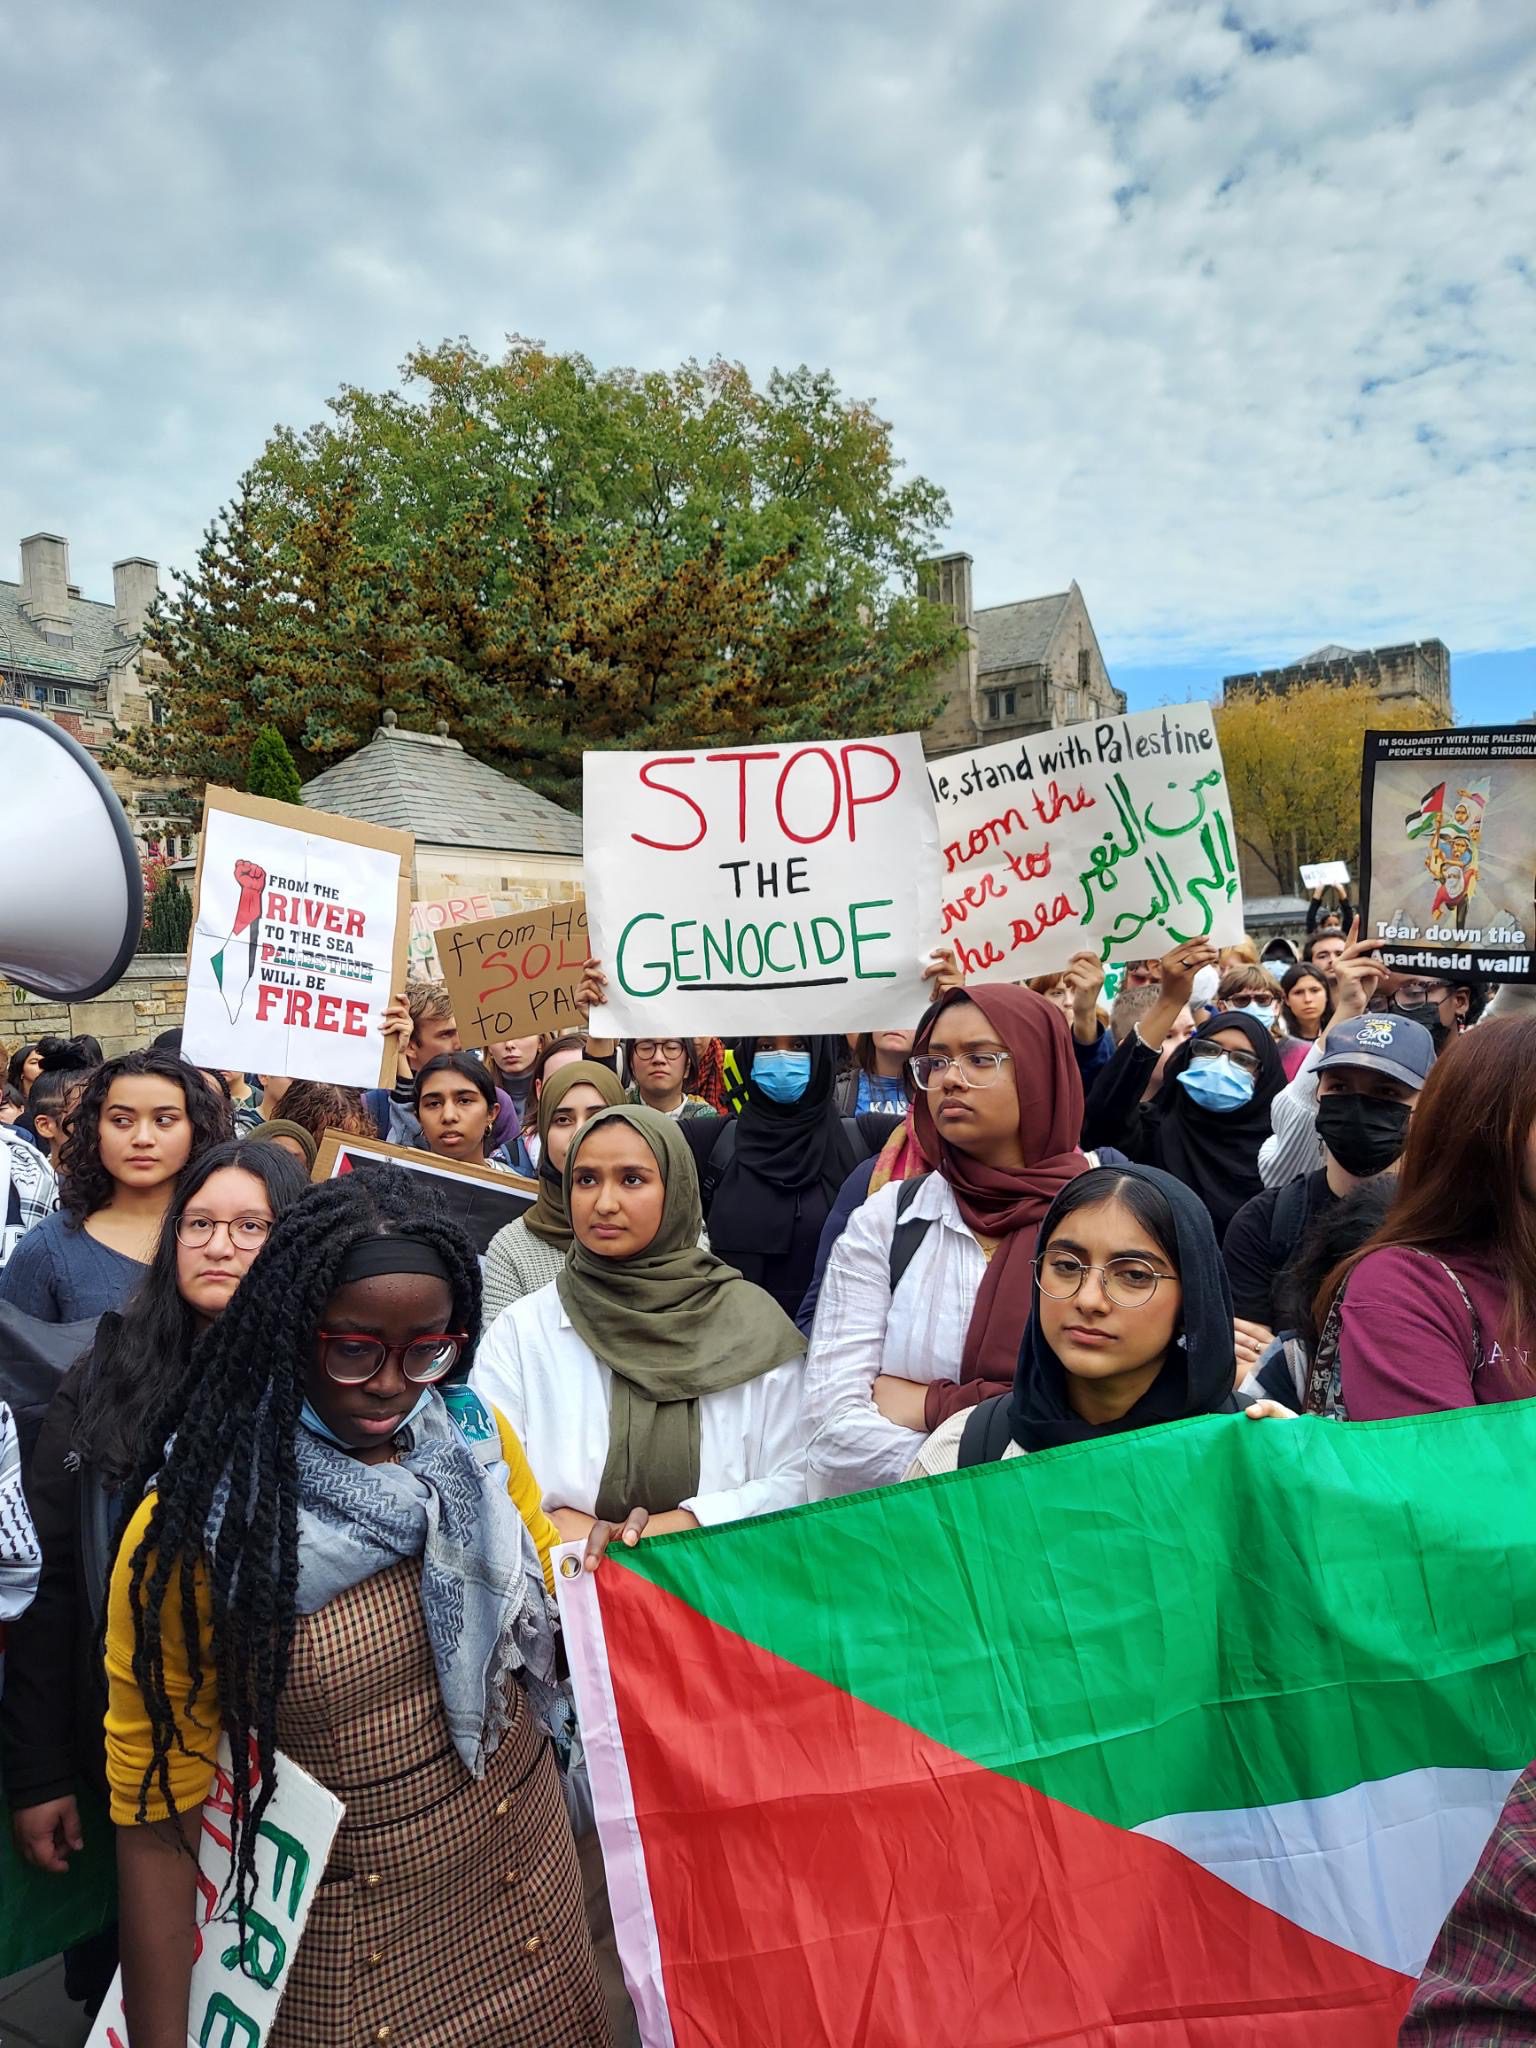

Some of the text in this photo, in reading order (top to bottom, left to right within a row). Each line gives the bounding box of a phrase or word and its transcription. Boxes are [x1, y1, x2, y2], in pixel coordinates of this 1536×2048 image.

[960, 745, 1033, 797] stand
[1039, 735, 1092, 776] with
[1095, 714, 1213, 765] Palestine
[1379, 733, 1536, 747] IN SOLIDARITY WITH THE PALESTIN
[1388, 747, 1432, 757] PEOPLE'S
[1434, 746, 1489, 756] LIBERATION
[631, 744, 901, 851] STOP
[1144, 769, 1222, 837] من
[943, 780, 1096, 873] rom the
[1003, 842, 1051, 881] to
[1079, 772, 1146, 926] النهر
[269, 876, 340, 901] FROM THE
[719, 857, 810, 898] THE
[266, 892, 365, 939] RIVER
[1100, 851, 1183, 962] البحر
[265, 924, 354, 954] TO THE SEA
[448, 926, 535, 977] from
[616, 899, 897, 998] GENOCIDE
[953, 892, 1078, 975] he sea
[1376, 921, 1526, 944] Tear down the
[260, 943, 374, 979] PALESTINE
[260, 968, 326, 991] WILL BE
[1371, 950, 1530, 973] Apartheid wall!
[255, 985, 369, 1038] FREE
[471, 1006, 513, 1041] to
